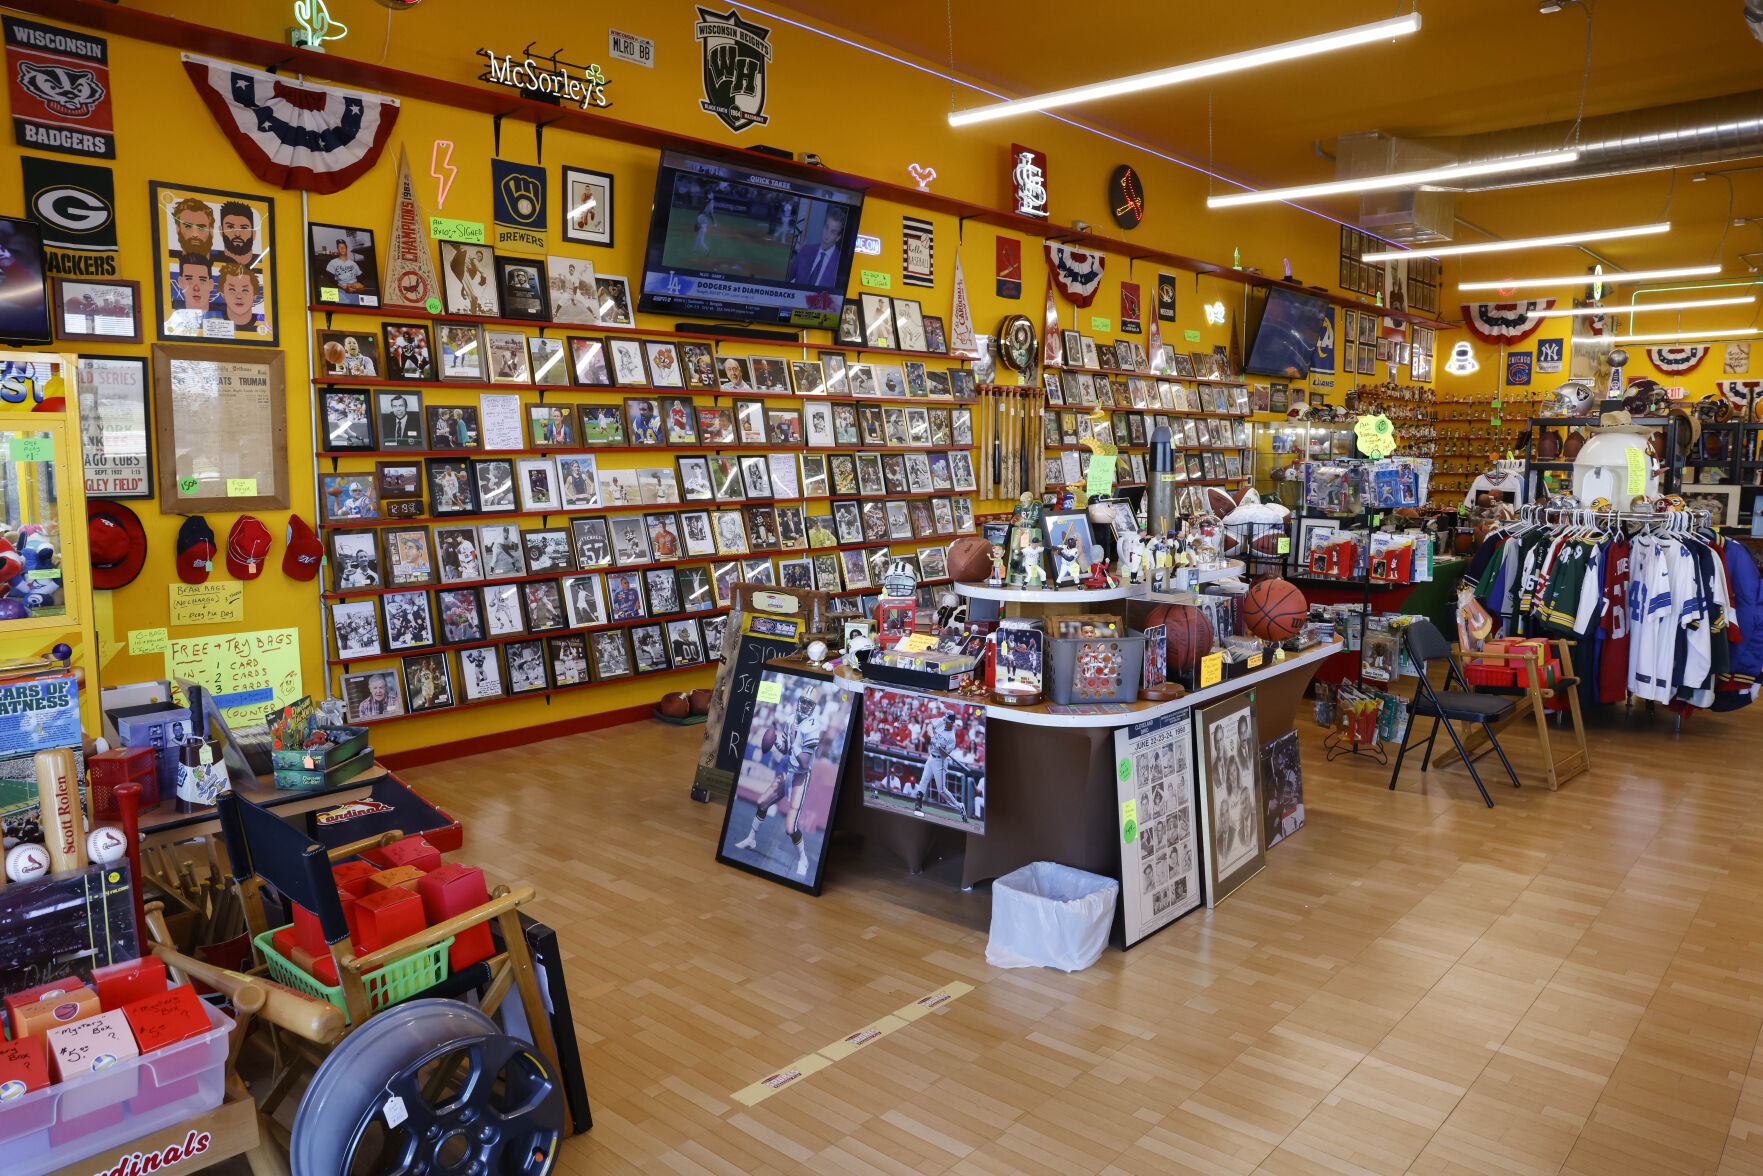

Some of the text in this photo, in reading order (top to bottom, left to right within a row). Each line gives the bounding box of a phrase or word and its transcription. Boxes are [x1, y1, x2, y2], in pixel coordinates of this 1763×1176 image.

[12, 26, 102, 58] WISCONSIN
[699, 25, 769, 55] WISCONSIN HEIGHTS
[613, 37, 650, 60] MLRD BB
[25, 124, 106, 153] BADGERS
[750, 175, 770, 186] QUICK
[401, 201, 418, 263] CHAMPIONS
[499, 232, 544, 248] BREWERS
[697, 281, 732, 292] DODGERS
[742, 287, 795, 299] DIAMONDBACKS
[100, 371, 137, 386] SERIES
[239, 377, 267, 386] TRUMAN
[1666, 387, 1680, 398] EXIT
[583, 542, 603, 565] 57
[171, 642, 209, 661] FREE
[225, 637, 251, 657] TRY
[256, 634, 293, 648] BAGS
[230, 658, 259, 671] CARD
[214, 667, 268, 683] 2 CARDS
[46, 681, 70, 695] OF
[215, 684, 223, 694] 3
[232, 680, 271, 692] CARDS
[1134, 720, 1154, 730] CLEVELAND
[1134, 739, 1150, 751] JUNE
[55, 775, 76, 855] Scott Rolen
[317, 801, 394, 826] Cardinals
[92, 1025, 113, 1035] Box
